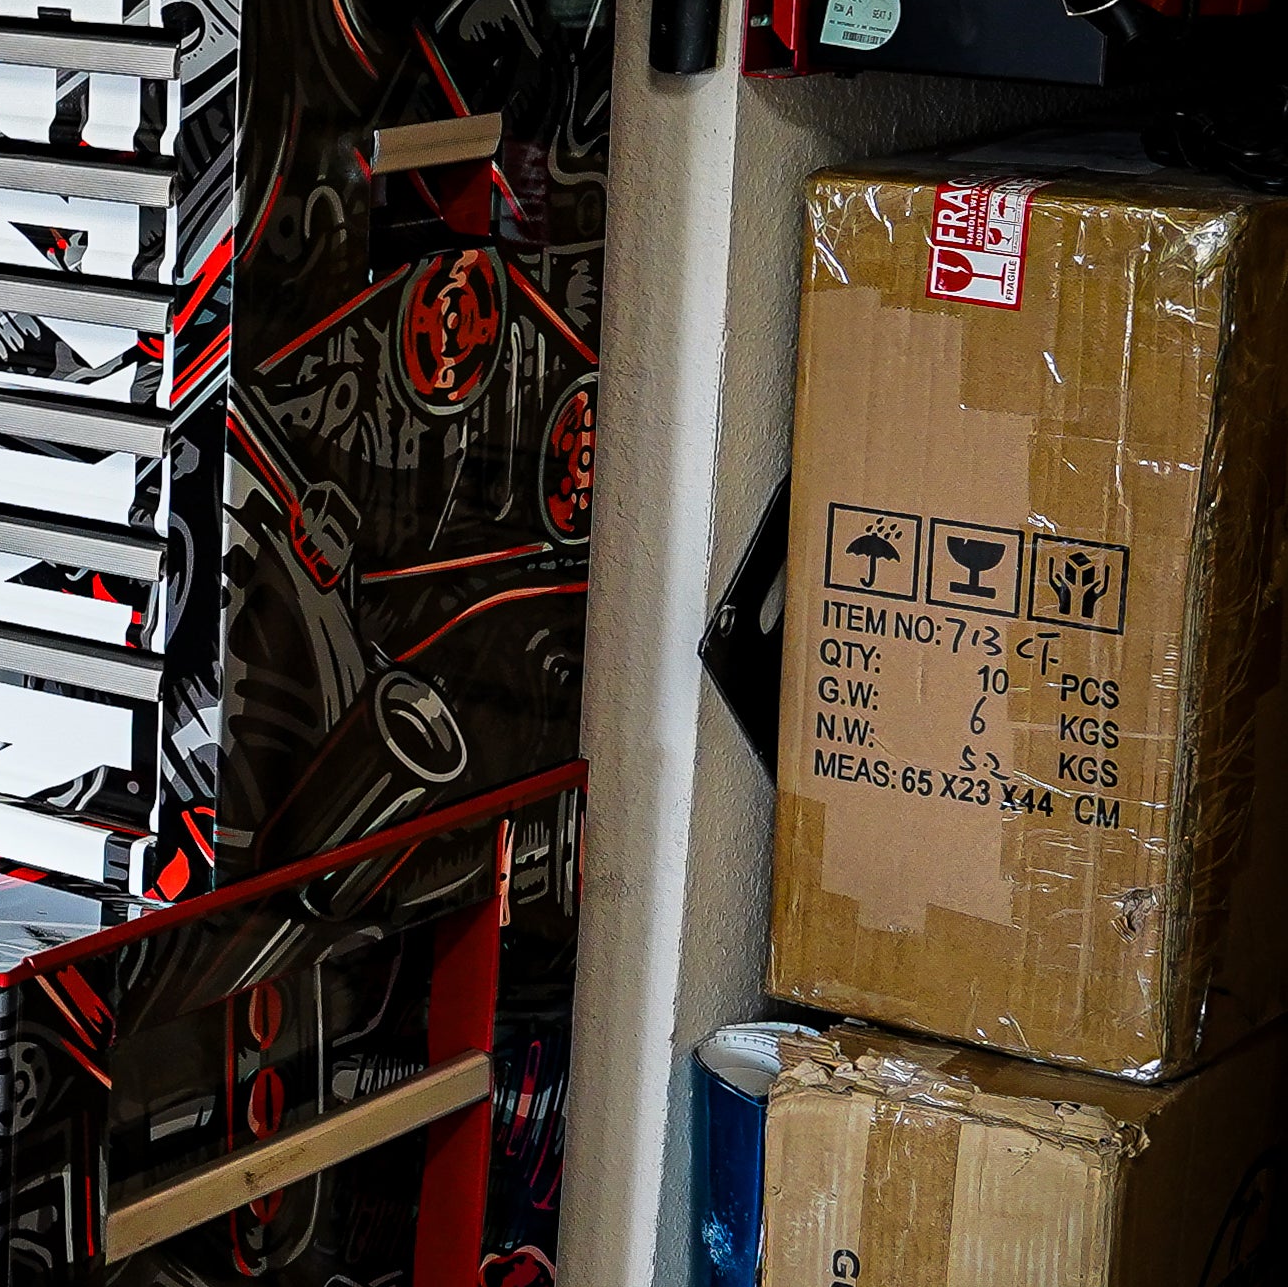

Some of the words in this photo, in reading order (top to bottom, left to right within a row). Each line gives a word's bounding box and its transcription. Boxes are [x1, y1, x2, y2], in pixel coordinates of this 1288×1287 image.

[845, 6, 853, 17] A
[966, 209, 977, 245] HANDLE
[975, 219, 985, 246] DON'T
[1005, 259, 1017, 300] FRAGILE
[822, 599, 886, 635] ITEM
[894, 615, 942, 646] NO:
[819, 638, 882, 674] QTY:
[977, 665, 1010, 695] 10
[1060, 674, 1120, 709] PCS
[818, 676, 879, 711] G.W:
[970, 696, 987, 735] 6
[1059, 713, 1120, 750] KGS
[815, 712, 875, 748] N.W:
[1058, 753, 1119, 788] KGS
[813, 748, 897, 790] MEAS:
[901, 766, 933, 797] 65
[1074, 795, 1120, 829] CM
